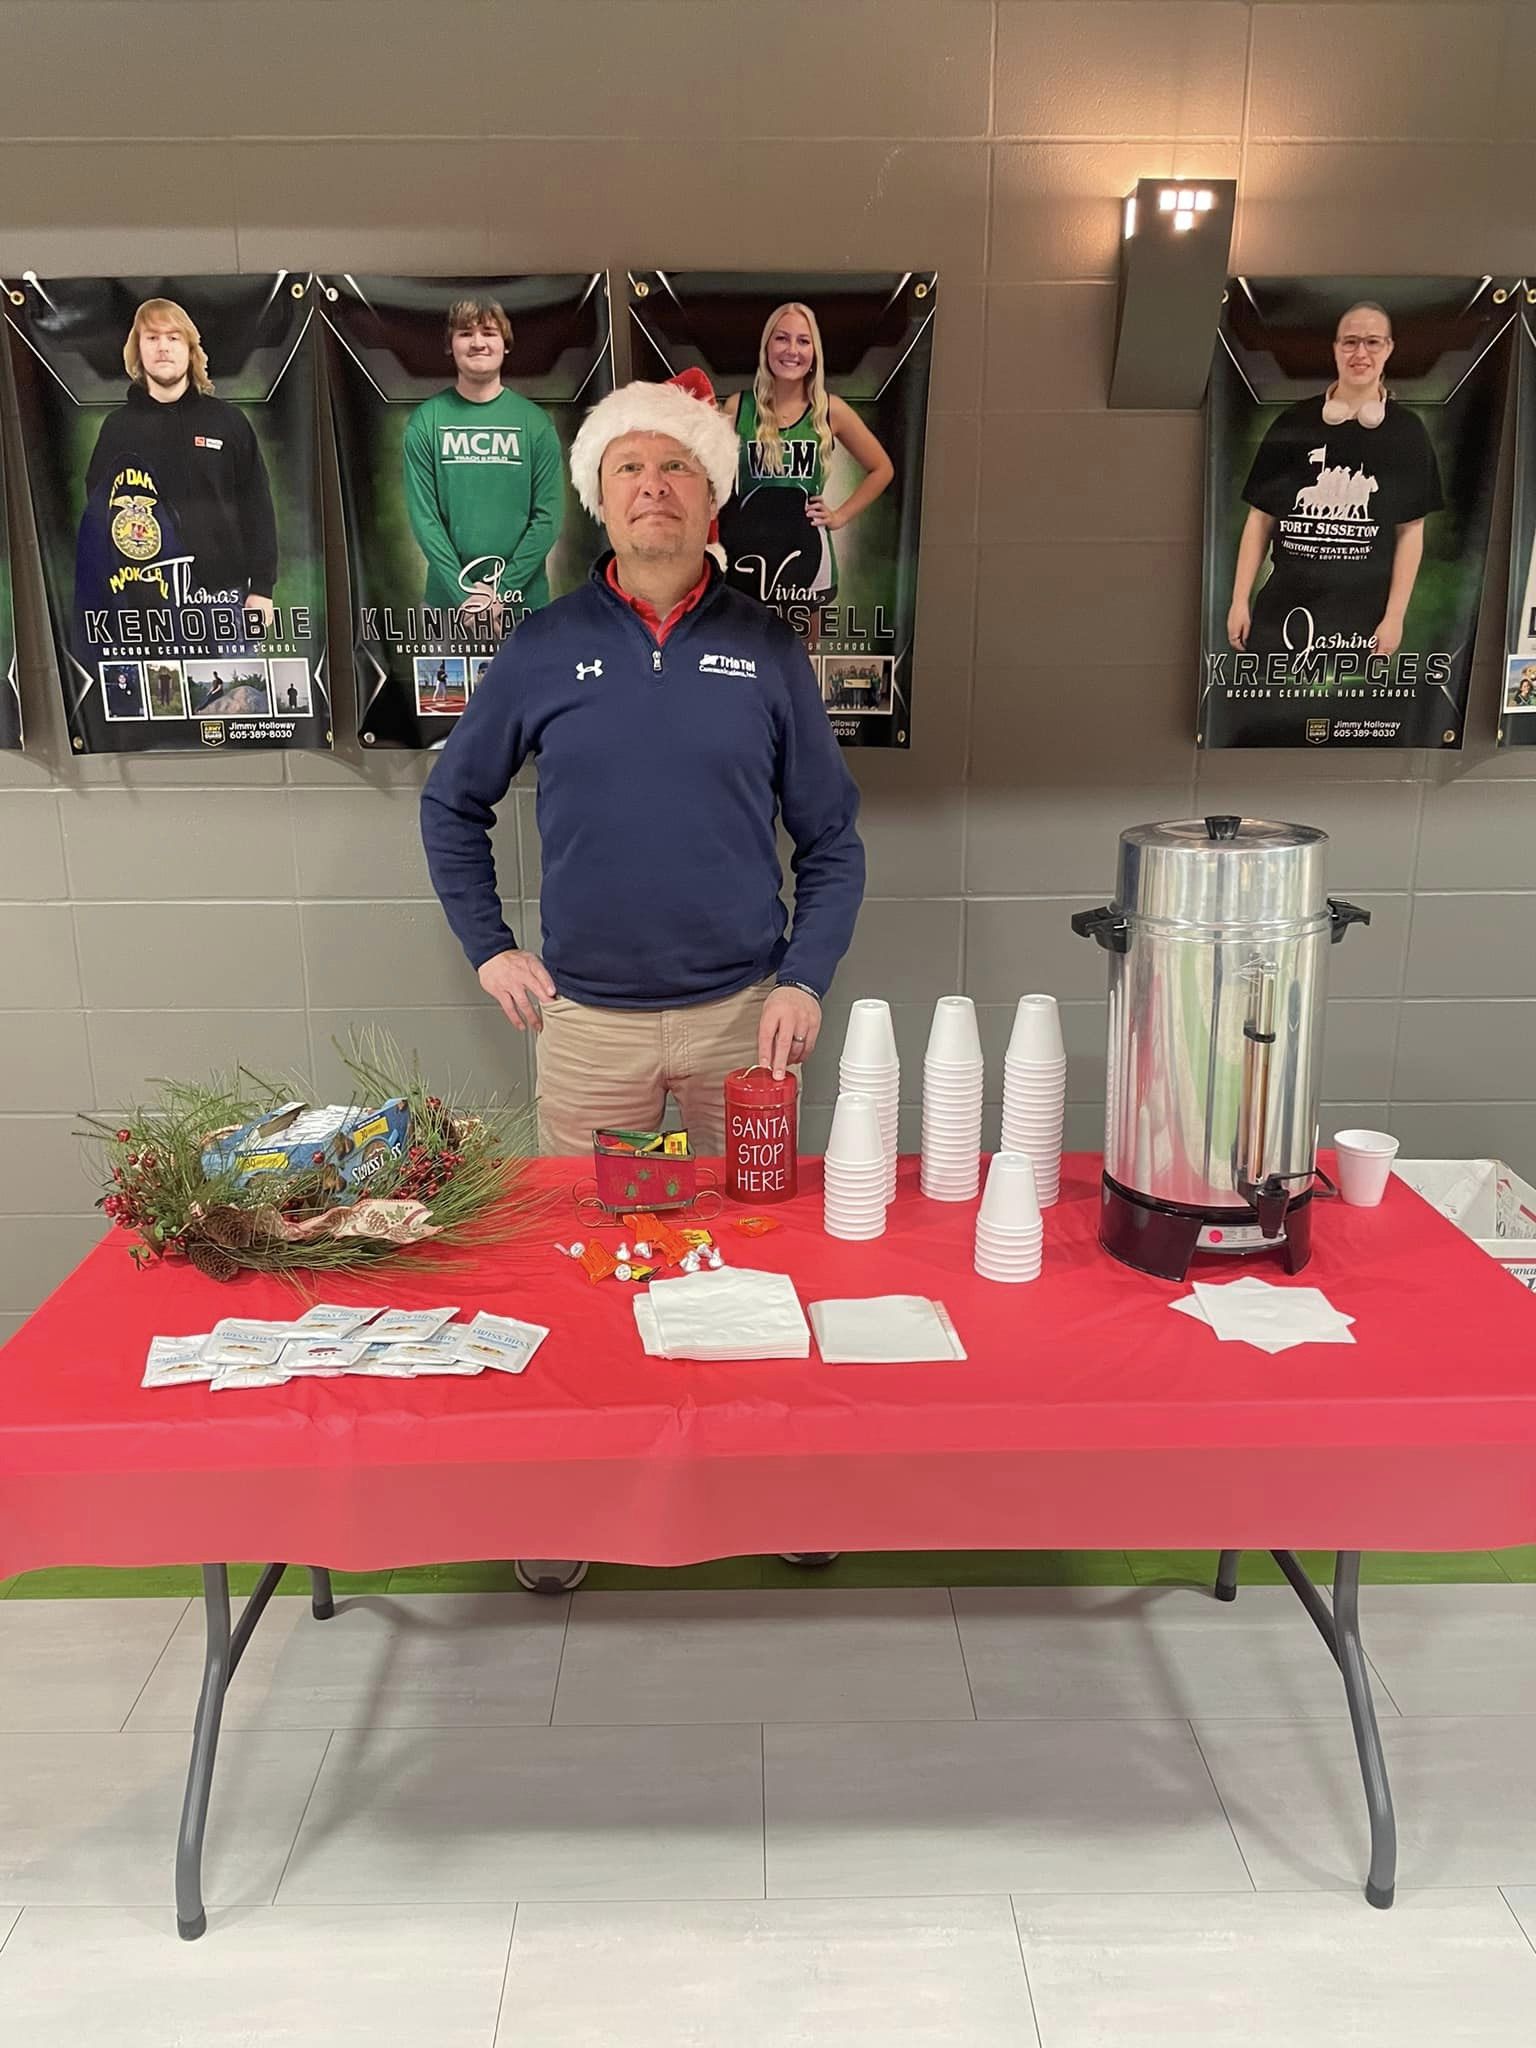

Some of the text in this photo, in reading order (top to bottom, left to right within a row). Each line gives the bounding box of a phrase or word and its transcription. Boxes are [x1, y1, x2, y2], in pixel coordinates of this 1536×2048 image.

[442, 432, 519, 456] MCM
[1280, 520, 1379, 537] FORT SISSETON
[1283, 540, 1319, 553] HISTORIC
[141, 556, 238, 607] Thomas
[458, 555, 525, 613] Shea
[735, 550, 826, 603] Vivian
[85, 607, 312, 643] KENOBBIE
[360, 607, 533, 641] KLINKHA
[766, 605, 895, 639] SELL
[103, 643, 298, 656] MCCOOK CENTRAL HIGH SCHOOL
[397, 645, 442, 654] MCCOOK
[829, 642, 872, 651] SCHOOL
[1283, 607, 1378, 673] Jasmine
[1208, 653, 1452, 687] KREMPGES
[1227, 688, 1416, 698] MCCOOK CENTRAL HIGH SCHOOL
[229, 722, 257, 731] Jimmy
[259, 721, 295, 730] Holloway
[229, 730, 292, 739] 605-389-8030
[830, 720, 860, 729] olloway
[1333, 720, 1400, 729] Jimmy Holloway
[1333, 729, 1395, 737] 605-389-8030
[732, 1115, 789, 1138] SANTA
[738, 1143, 784, 1166] STOP
[737, 1168, 785, 1192] HERE
